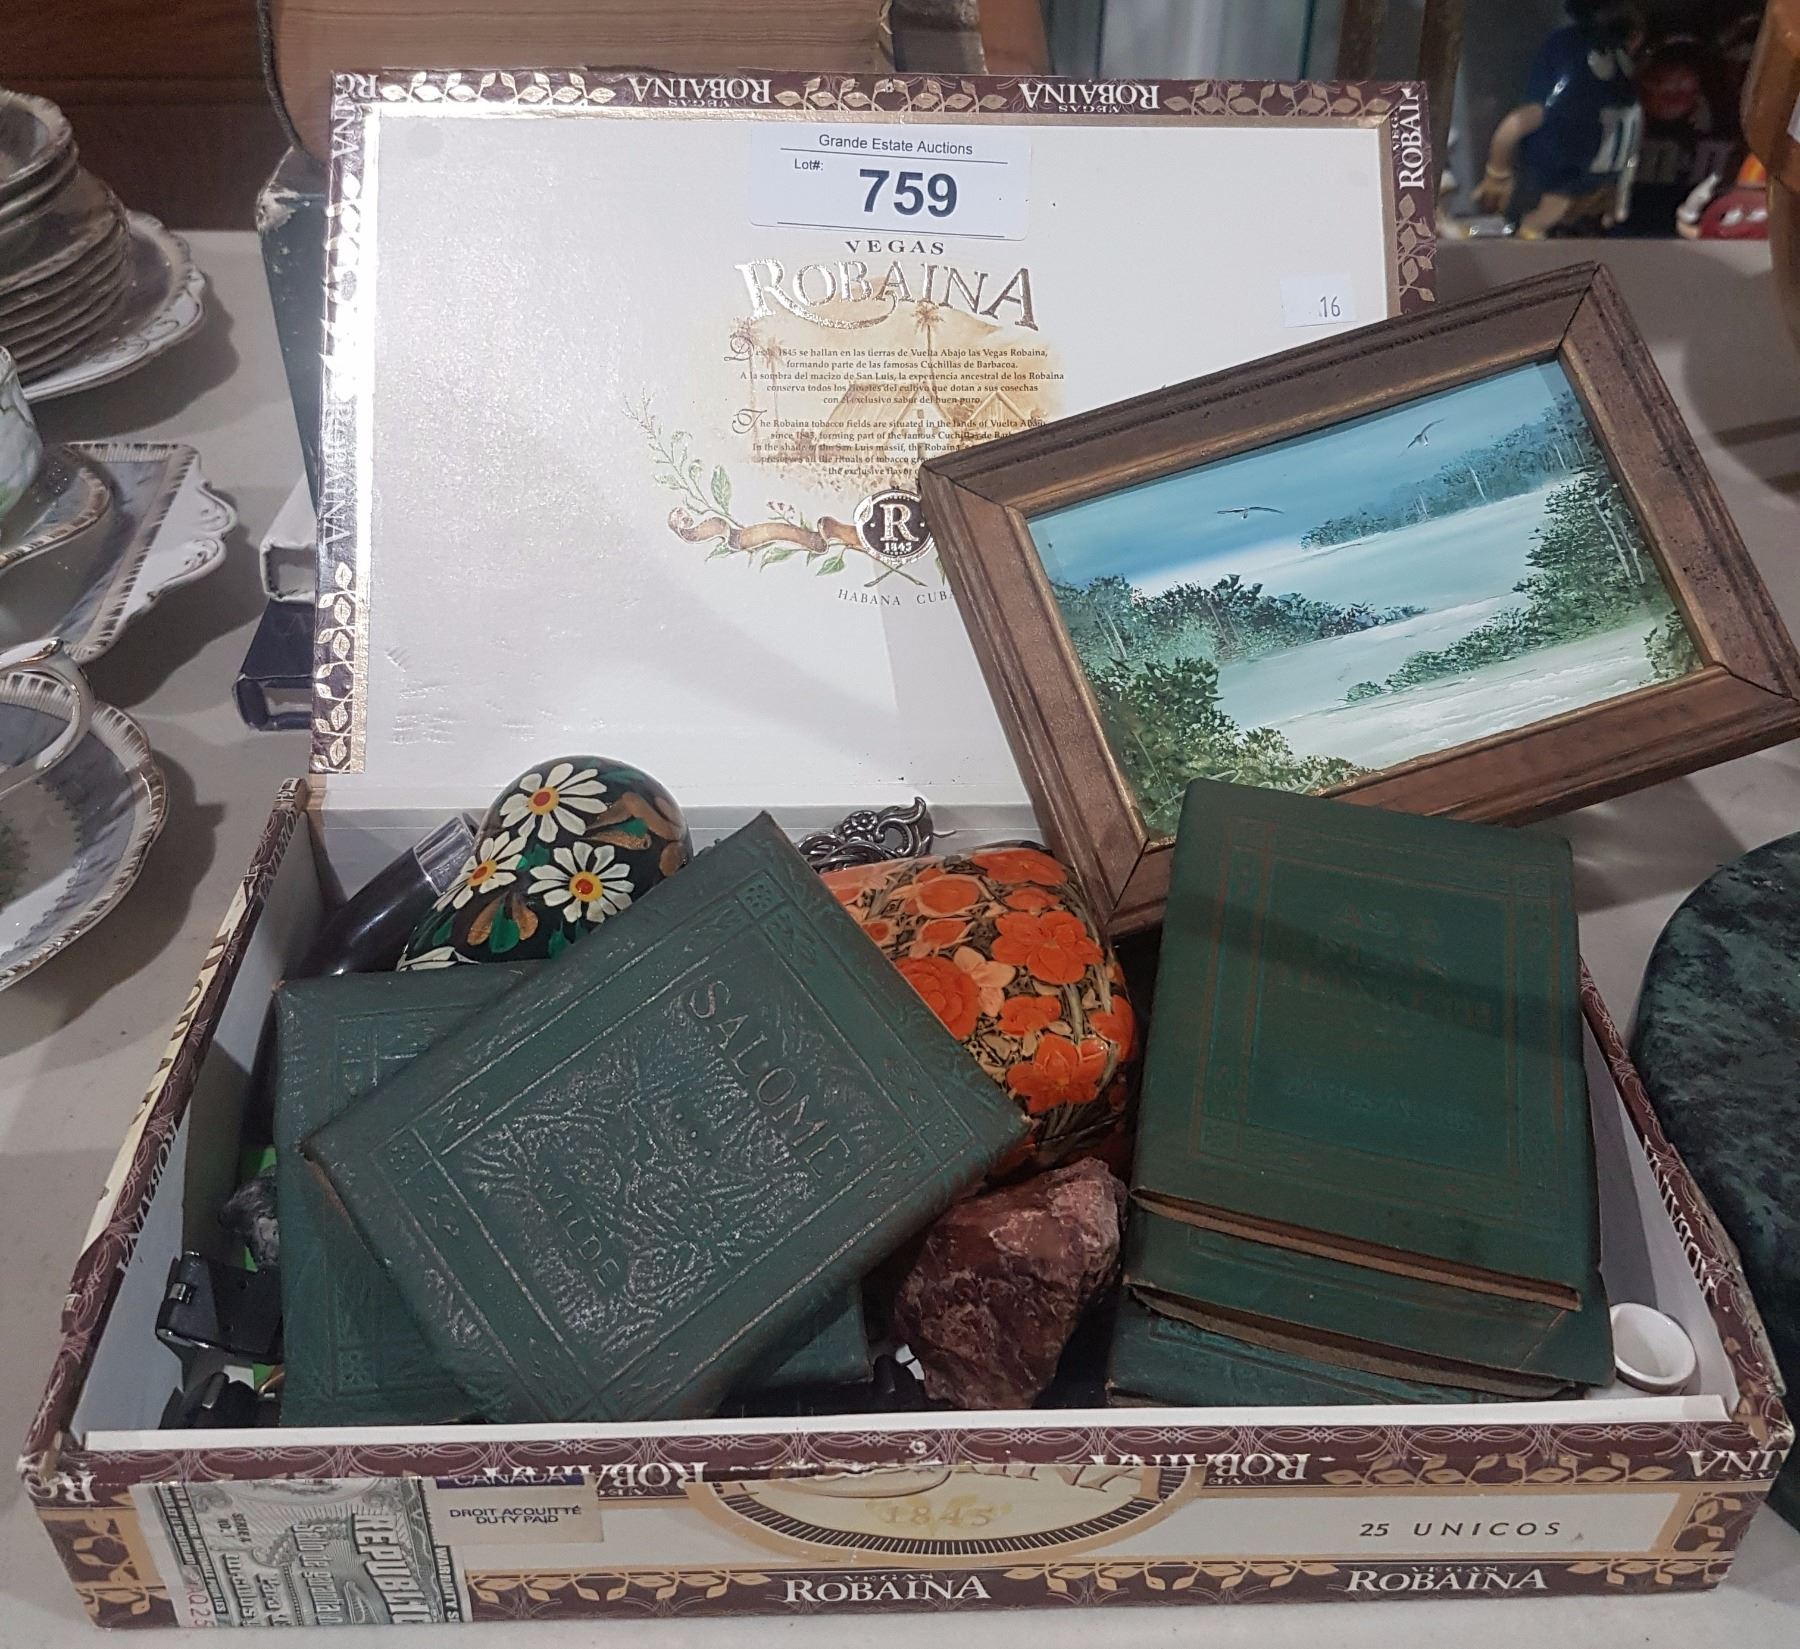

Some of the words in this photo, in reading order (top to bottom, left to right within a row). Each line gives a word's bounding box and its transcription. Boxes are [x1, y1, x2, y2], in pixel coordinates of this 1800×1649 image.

[627, 77, 773, 104] ROBAINA
[1018, 82, 1161, 109] ROBAINA
[1058, 105, 1121, 113] VEGAS
[818, 133, 867, 149] Grande
[872, 137, 913, 152] Estate
[917, 139, 973, 155] Auctions
[794, 157, 824, 171] Lot#:
[859, 168, 958, 218] 759
[844, 239, 945, 255] VEGAS
[734, 257, 1039, 331] ROBAINA
[1319, 295, 1341, 318] 16
[779, 348, 797, 357] 1845
[810, 348, 838, 357] hallan
[840, 348, 851, 357] en
[853, 348, 866, 357] las
[867, 348, 895, 357] tierras
[897, 348, 908, 357] de
[910, 348, 938, 357] Vuelta
[941, 348, 966, 359] Abajo
[968, 348, 981, 357] las
[982, 348, 1008, 359] Vegas
[1010, 348, 1048, 359] Robaina,
[786, 360, 830, 369] formando
[831, 360, 854, 371] parte
[883, 360, 919, 369] famosas
[920, 360, 961, 369] Cuchillas
[976, 360, 1018, 369] Barbacoa.
[760, 372, 792, 380] sombra
[794, 372, 808, 380] del
[810, 372, 841, 380] macizo
[856, 372, 873, 380] San
[875, 372, 897, 382] Luis,
[960, 372, 998, 380] ancestral
[1029, 372, 1064, 380] Robaina
[807, 383, 832, 392] todos
[834, 383, 847, 392] los
[931, 385, 948, 394] que
[950, 383, 974, 392] dotan
[1000, 383, 1038, 392] cosechas
[773, 419, 809, 428] Robaina
[811, 419, 845, 428] tobacco
[846, 419, 871, 428] fields
[873, 419, 887, 428] are
[888, 419, 924, 428] situated
[926, 419, 935, 428] in
[937, 419, 951, 428] the
[953, 419, 976, 428] lands
[978, 419, 987, 428] of
[989, 419, 1018, 428] Vuelta
[770, 431, 793, 440] since
[819, 431, 855, 442] forming
[857, 431, 875, 442] part
[879, 503, 919, 541] R
[838, 588, 901, 606] HABANA
[450, 1508, 497, 1517] DROIT
[476, 1515, 521, 1524] DUTY
[523, 1514, 559, 1524] PAID
[881, 1504, 996, 1527] 1845
[1359, 1522, 1390, 1537] 25
[1412, 1521, 1561, 1536] UNICOS
[435, 1547, 459, 1609] WARRANTY
[1344, 1568, 1549, 1592] ROBAINA
[784, 1575, 993, 1602] ROBAINA
